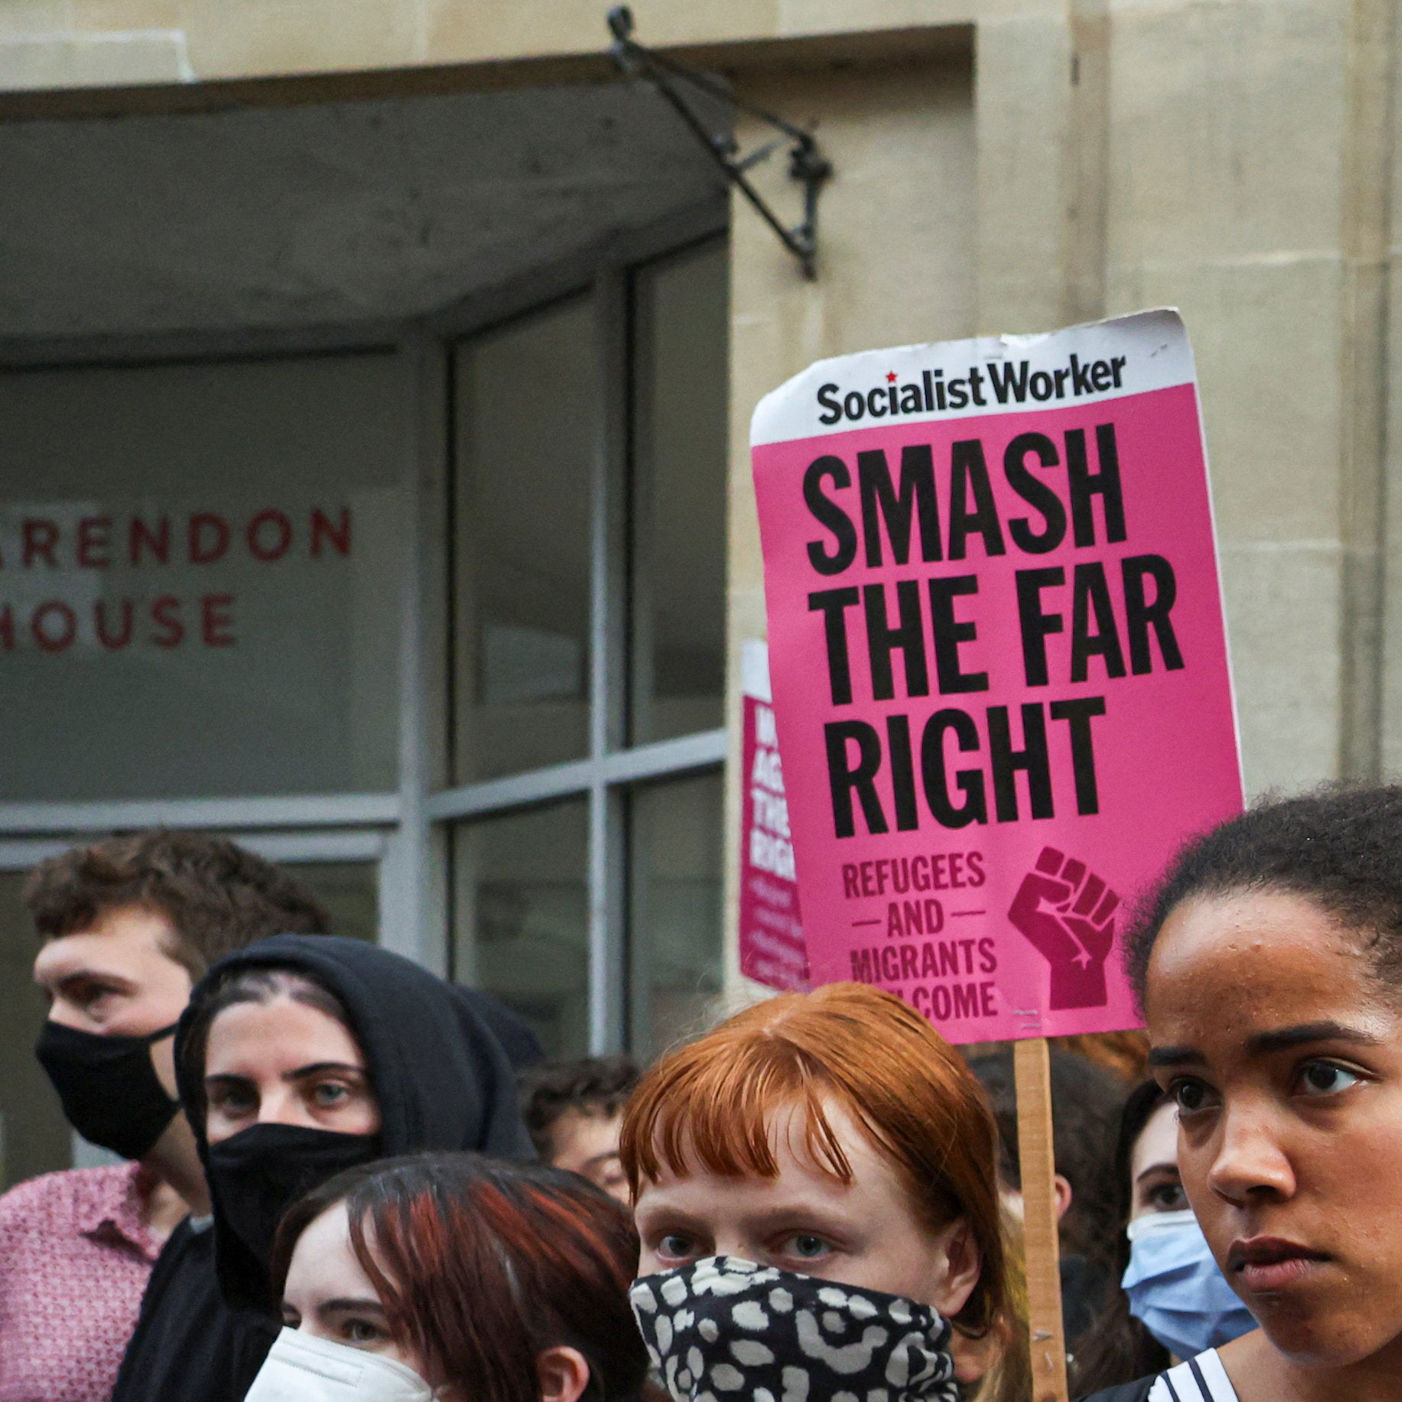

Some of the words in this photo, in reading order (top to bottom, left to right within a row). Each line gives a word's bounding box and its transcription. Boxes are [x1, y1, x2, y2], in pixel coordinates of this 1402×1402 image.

[803, 423, 1127, 577] SMASH
[0, 507, 352, 570] RENDON
[807, 574, 989, 706] THE
[1015, 553, 1185, 688] FAR
[824, 696, 1107, 840] RIGHT
[842, 851, 987, 899] REFUGEES
[886, 899, 945, 938] AND
[850, 937, 998, 984] MIGRANTS
[887, 981, 999, 1021] COME
